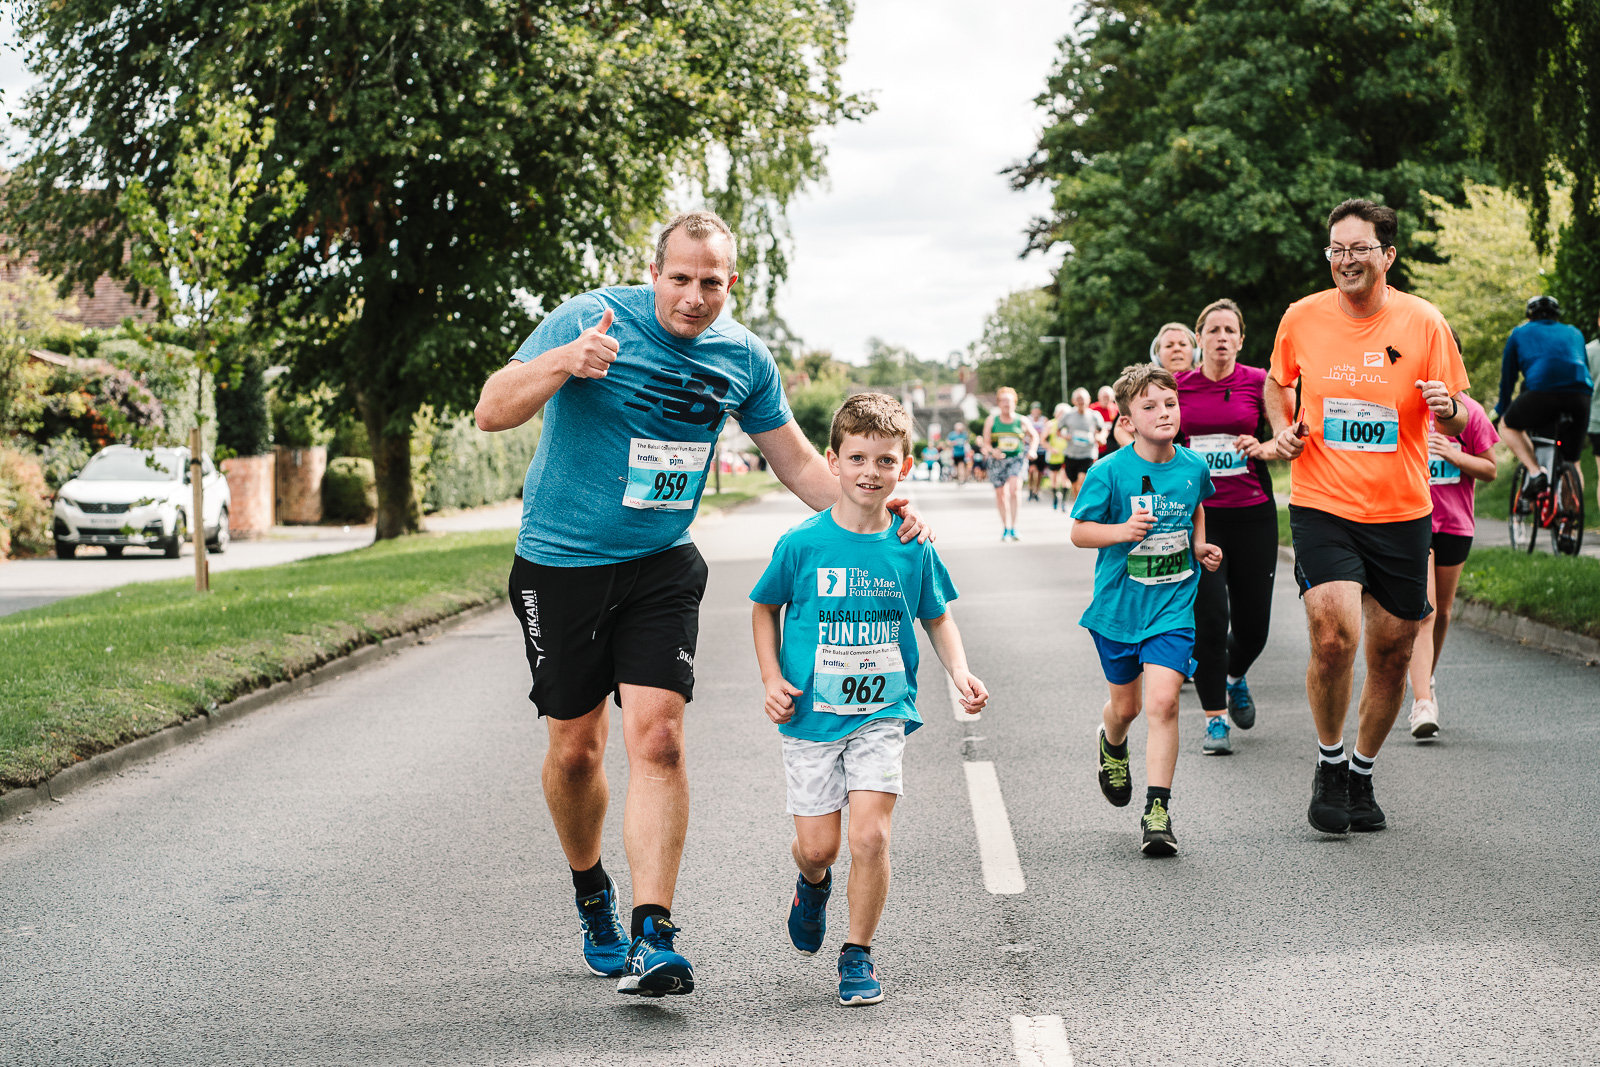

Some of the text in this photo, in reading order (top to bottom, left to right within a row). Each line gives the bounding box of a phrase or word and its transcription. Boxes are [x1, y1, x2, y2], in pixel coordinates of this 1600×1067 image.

[1342, 420, 1385, 444] 1009
[669, 458, 684, 466] pjm
[1206, 452, 1233, 469] 960
[1430, 461, 1445, 477] 61
[653, 472, 688, 500] 959
[1153, 494, 1167, 502] The
[1169, 501, 1186, 510] Mae
[1154, 509, 1188, 517] oundation
[1147, 552, 1182, 577] 1229
[849, 567, 869, 577] The
[849, 577, 895, 589] Lily Mae
[849, 587, 902, 599] Foundation
[521, 590, 539, 637] OKAMI
[819, 609, 904, 623] BALSALL COMMON
[818, 620, 890, 645] FUN RUN
[859, 661, 876, 669] pjm
[842, 675, 886, 704] 962
